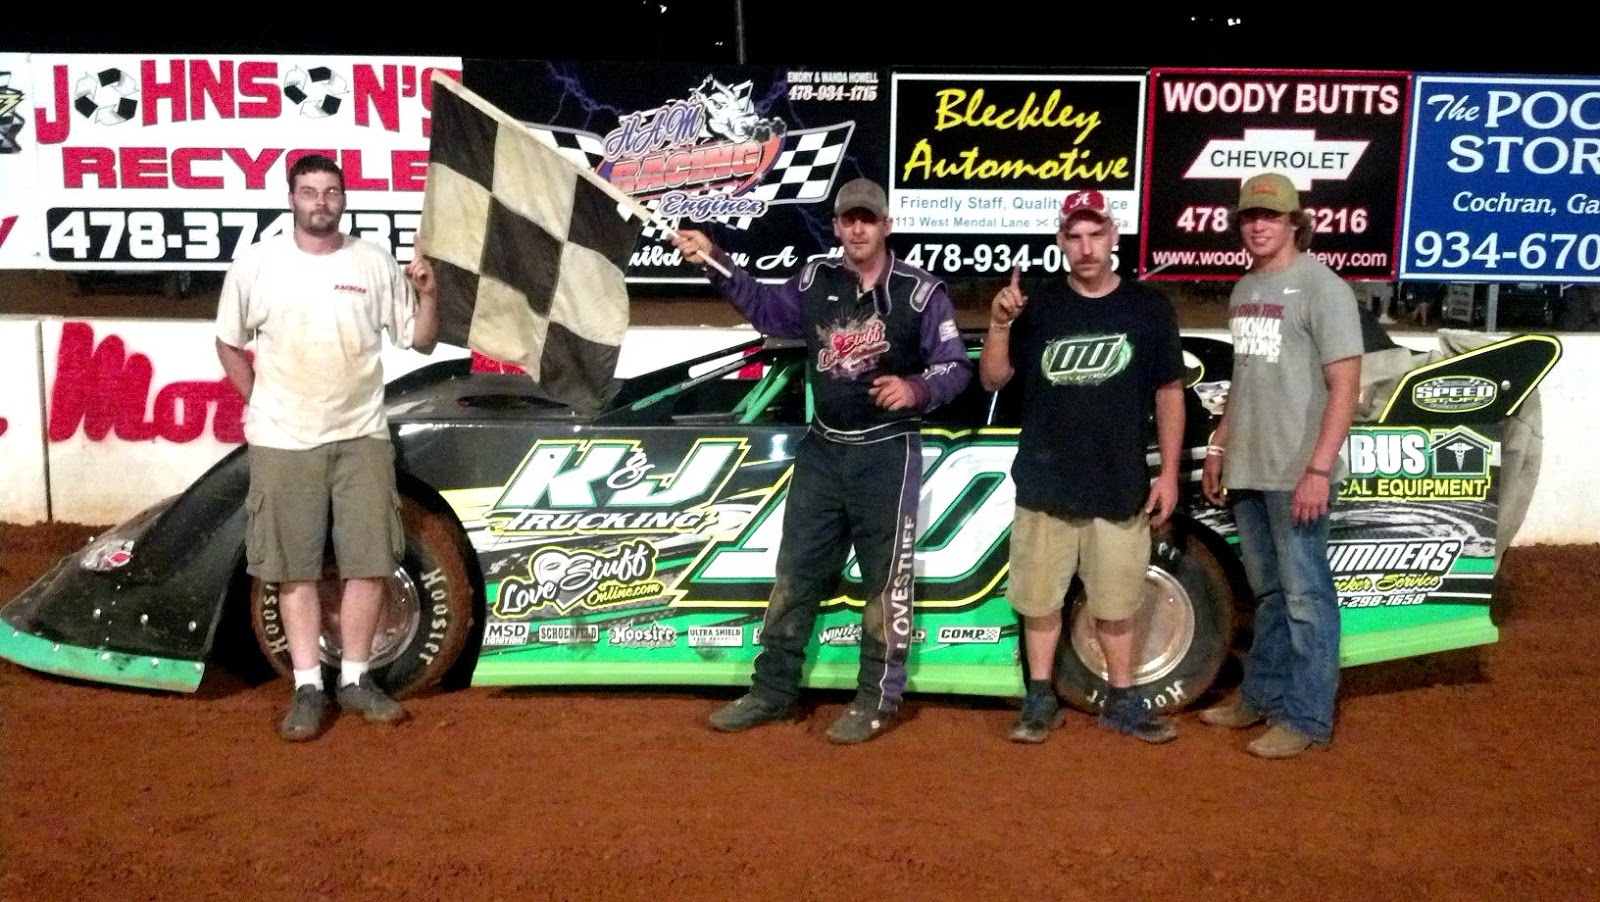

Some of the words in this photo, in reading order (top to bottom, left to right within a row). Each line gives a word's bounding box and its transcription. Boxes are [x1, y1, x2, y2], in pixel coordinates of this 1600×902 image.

[848, 72, 879, 84] HOWELL
[788, 84, 878, 101] 478-934-1715
[1163, 83, 1286, 114] WOODY
[1295, 85, 1399, 115] BUTTS
[934, 88, 1101, 145] Bleckley
[1427, 93, 1481, 123] The
[902, 138, 1130, 182] Automotive
[1210, 149, 1350, 170] CHEVROLET
[900, 196, 962, 212] Friendly
[968, 196, 1007, 211] Staff,
[1452, 190, 1557, 217] Cochran,
[896, 217, 916, 227] 113
[919, 217, 949, 228] West
[953, 217, 997, 228] Mendal
[1001, 217, 1031, 228] Lane
[1416, 386, 1493, 398] SPEED
[1377, 480, 1485, 496] EQUIPMENT
[486, 511, 703, 532] TRUCKING
[560, 544, 649, 591] Stuff
[1375, 573, 1440, 592] Service
[500, 582, 557, 614] Love
[489, 624, 527, 637] MSD
[690, 628, 714, 636] ULTRA
[715, 628, 740, 636] SHIELD
[940, 628, 985, 639] COMP
